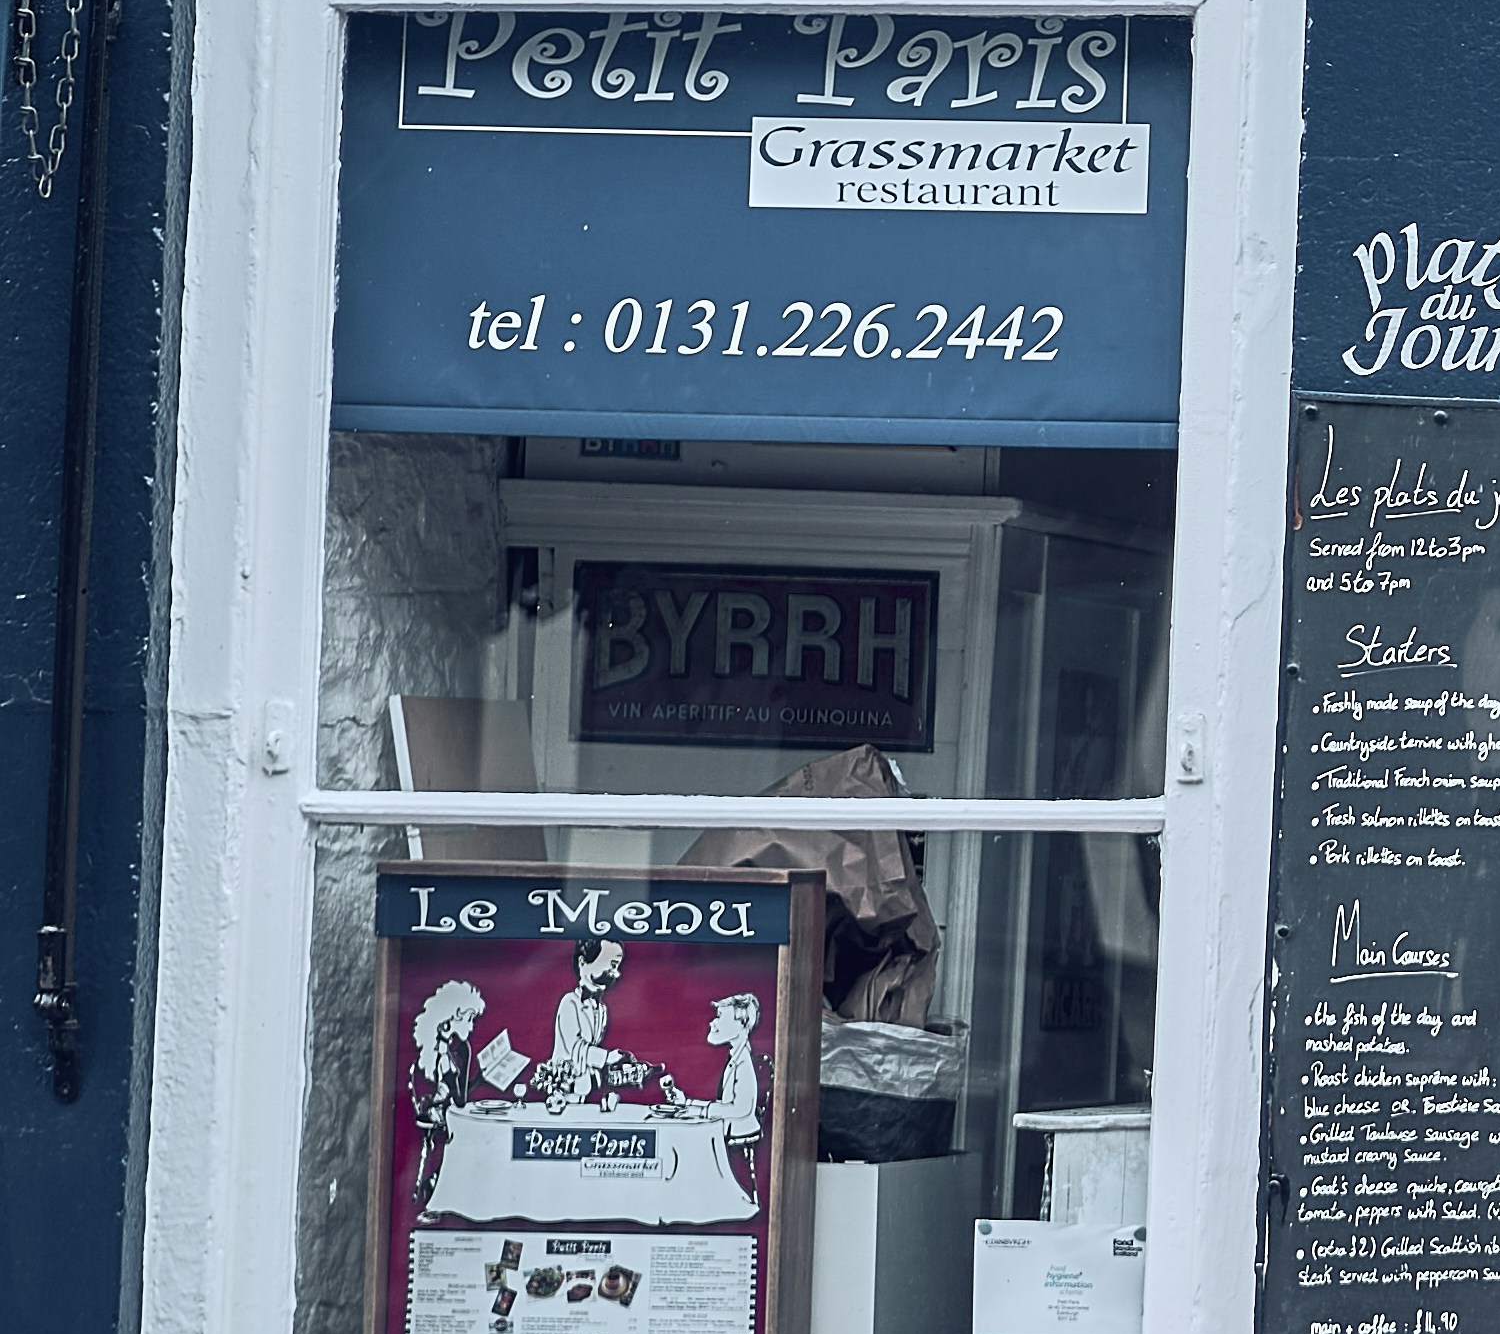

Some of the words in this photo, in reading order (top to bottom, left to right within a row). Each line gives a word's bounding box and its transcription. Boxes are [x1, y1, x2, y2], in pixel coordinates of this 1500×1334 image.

[414, 11, 746, 104] Petit
[795, 14, 1119, 114] Paris
[757, 124, 1138, 178] Grassmarket
[835, 175, 1061, 209] restaurant
[1420, 285, 1477, 321] du
[468, 293, 547, 354] tel
[602, 297, 1065, 363] 0131.226.2442
[1310, 424, 1362, 508] Les
[1370, 458, 1439, 528] plats
[1446, 469, 1480, 513] du
[1310, 537, 1363, 557] Served
[1366, 532, 1404, 570] from
[1307, 573, 1334, 591] and
[1378, 572, 1411, 595] 7pm
[593, 586, 914, 703] BYRRH
[1338, 625, 1451, 668] Starters
[608, 701, 642, 718] VIN
[744, 705, 770, 723] AU
[780, 706, 893, 727] QUINQUINA
[1323, 690, 1362, 719] Freshly
[1367, 693, 1398, 710] made
[1451, 693, 1474, 710] the
[1321, 732, 1398, 760] Countryside
[1448, 731, 1477, 751] with
[1317, 765, 1388, 789] Traditional
[1394, 767, 1430, 787] French
[1322, 802, 1355, 825] Fresh
[1361, 806, 1404, 827] salmon
[1319, 839, 1350, 864] Pork
[409, 886, 499, 934] Le
[527, 888, 756, 938] Menu
[1331, 899, 1385, 967] Main
[1392, 932, 1450, 967] Courses
[1341, 1003, 1367, 1035] fish
[1391, 1003, 1412, 1025] the
[1417, 1006, 1443, 1037] day
[1452, 1010, 1477, 1026] and
[1305, 1034, 1352, 1052] mashed
[1311, 1060, 1349, 1087] Roast
[1354, 1065, 1401, 1087] chicken
[1304, 1095, 1330, 1117] blue
[1334, 1094, 1380, 1115] cheese
[525, 1128, 582, 1156] Petit
[590, 1130, 647, 1157] Paris
[1310, 1123, 1354, 1144] Grilled
[1360, 1122, 1418, 1142] Toulouse
[1304, 1147, 1349, 1166] mustard
[1355, 1151, 1398, 1169] creamy
[1354, 1174, 1398, 1194] cheese
[1356, 1203, 1403, 1226] peppers
[1408, 1200, 1437, 1219] with
[1380, 1237, 1425, 1257] Grilled
